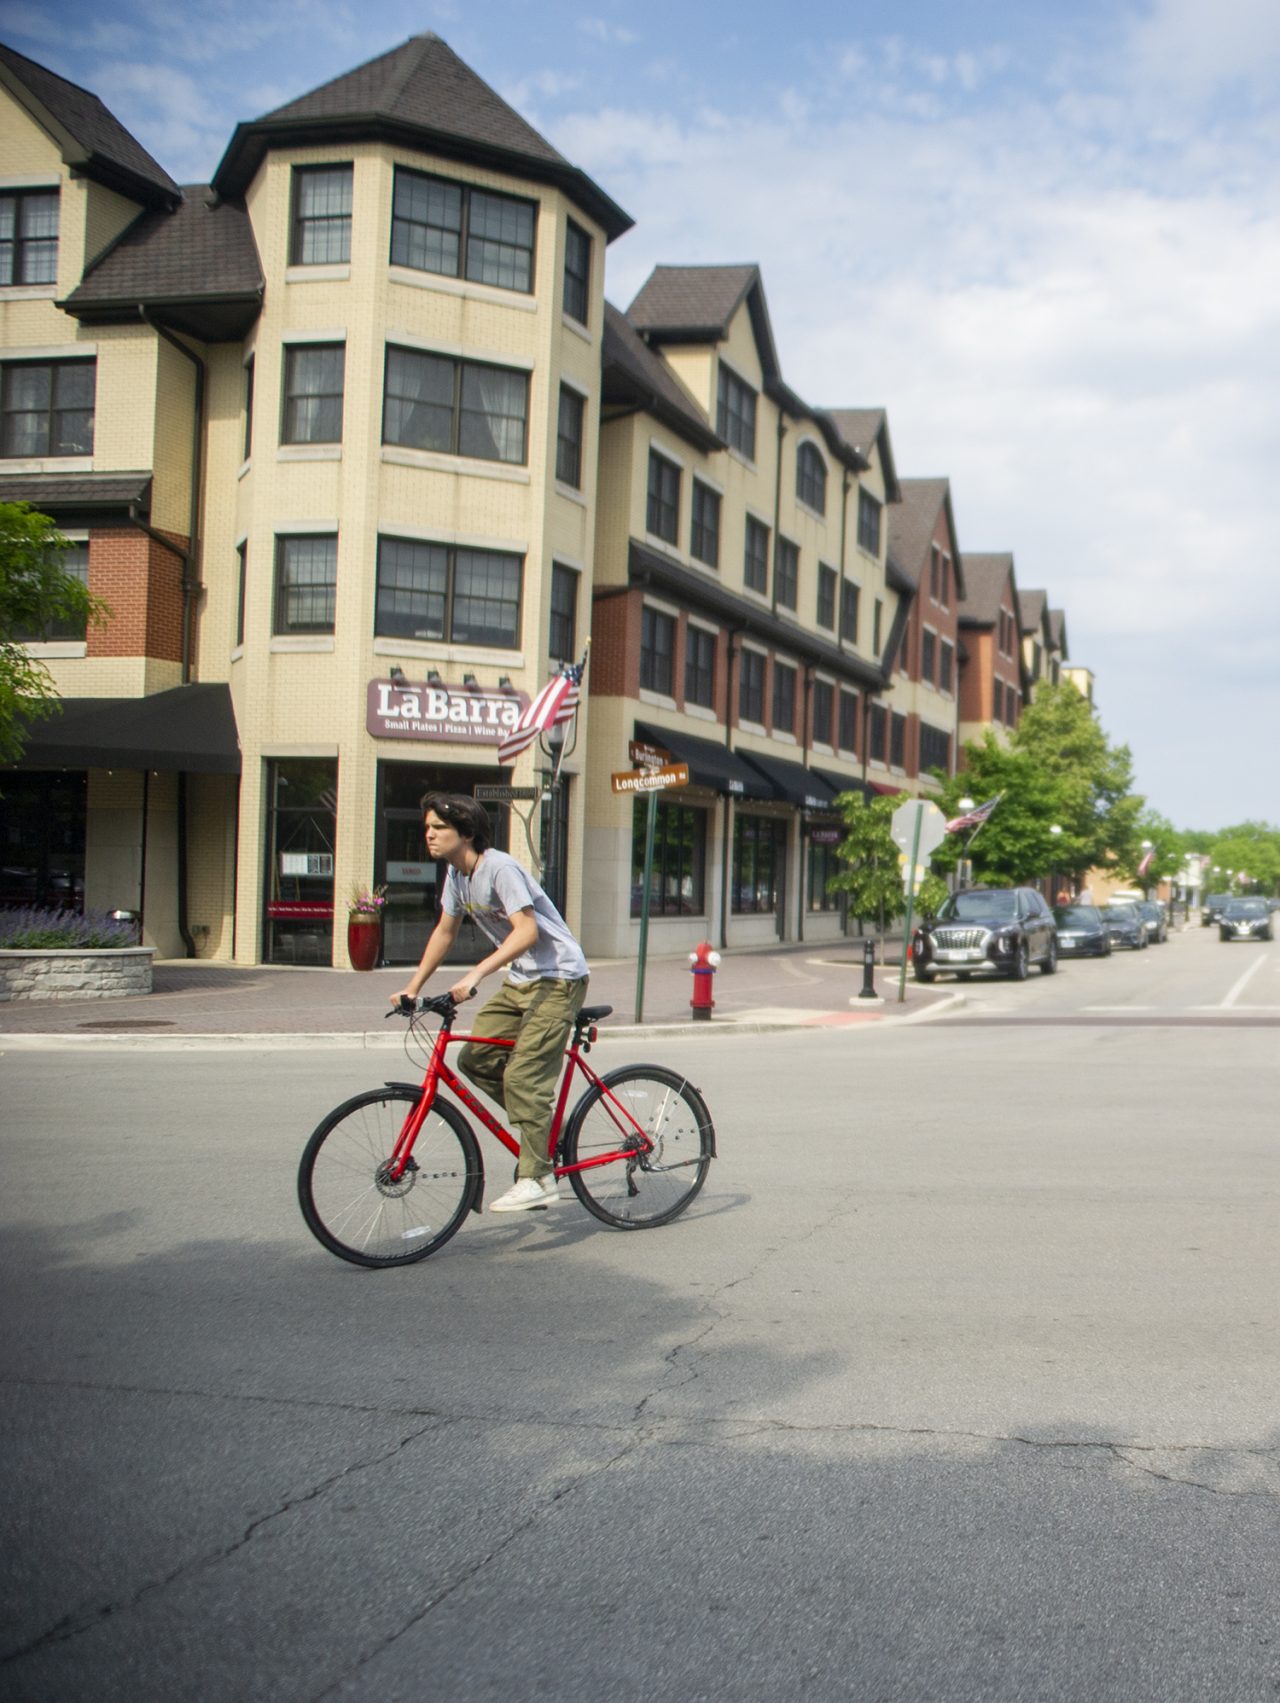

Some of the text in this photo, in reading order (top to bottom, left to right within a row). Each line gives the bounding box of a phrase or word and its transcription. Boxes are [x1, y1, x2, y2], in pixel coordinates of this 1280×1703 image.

[377, 684, 520, 726] La Barra
[384, 719, 410, 730] Small
[412, 721, 438, 733] Plates
[445, 723, 467, 735] Pizza
[474, 726, 496, 737] Wine
[616, 774, 676, 791] Longcommon
